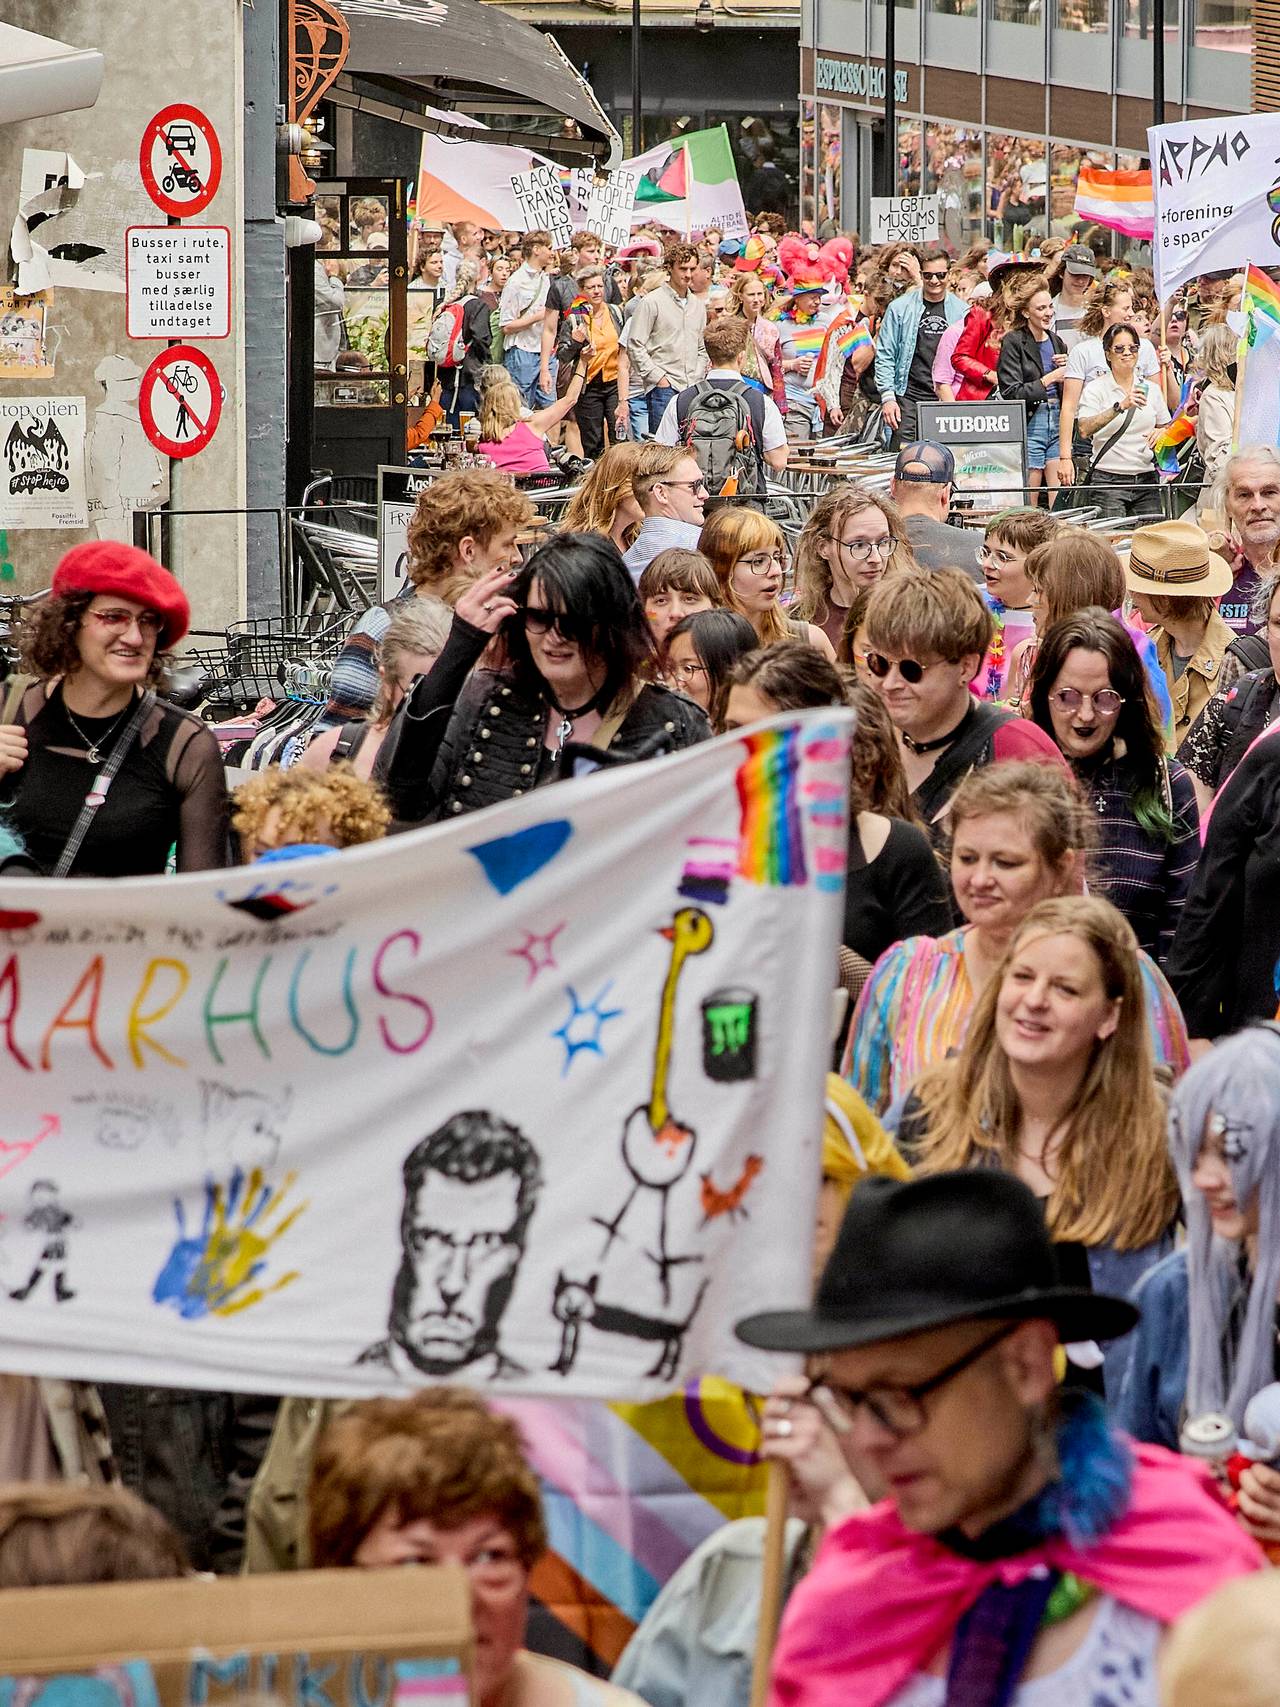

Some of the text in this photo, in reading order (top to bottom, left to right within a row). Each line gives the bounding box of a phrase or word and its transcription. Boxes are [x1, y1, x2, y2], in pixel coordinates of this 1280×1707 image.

[816, 57, 908, 103] ESPRESSO HOSE
[510, 165, 558, 195] BLACK
[608, 169, 635, 191] EER
[516, 185, 564, 214] TRANS
[600, 204, 618, 223] OF
[879, 209, 935, 229] MUSLIMS
[132, 237, 177, 248] Busser
[183, 237, 186, 248] i
[550, 224, 573, 246] TER
[887, 226, 928, 242] EXIST
[146, 253, 210, 264] taxi samt
[156, 269, 201, 279] busser
[141, 285, 215, 297] med særlig
[149, 300, 213, 311] tilladelse
[150, 316, 211, 328] undtaget
[36, 401, 79, 416] olien
[936, 415, 1010, 433] TUBORG
[1220, 603, 1249, 618] FSTB
[186, 1644, 393, 1707] MIKU
